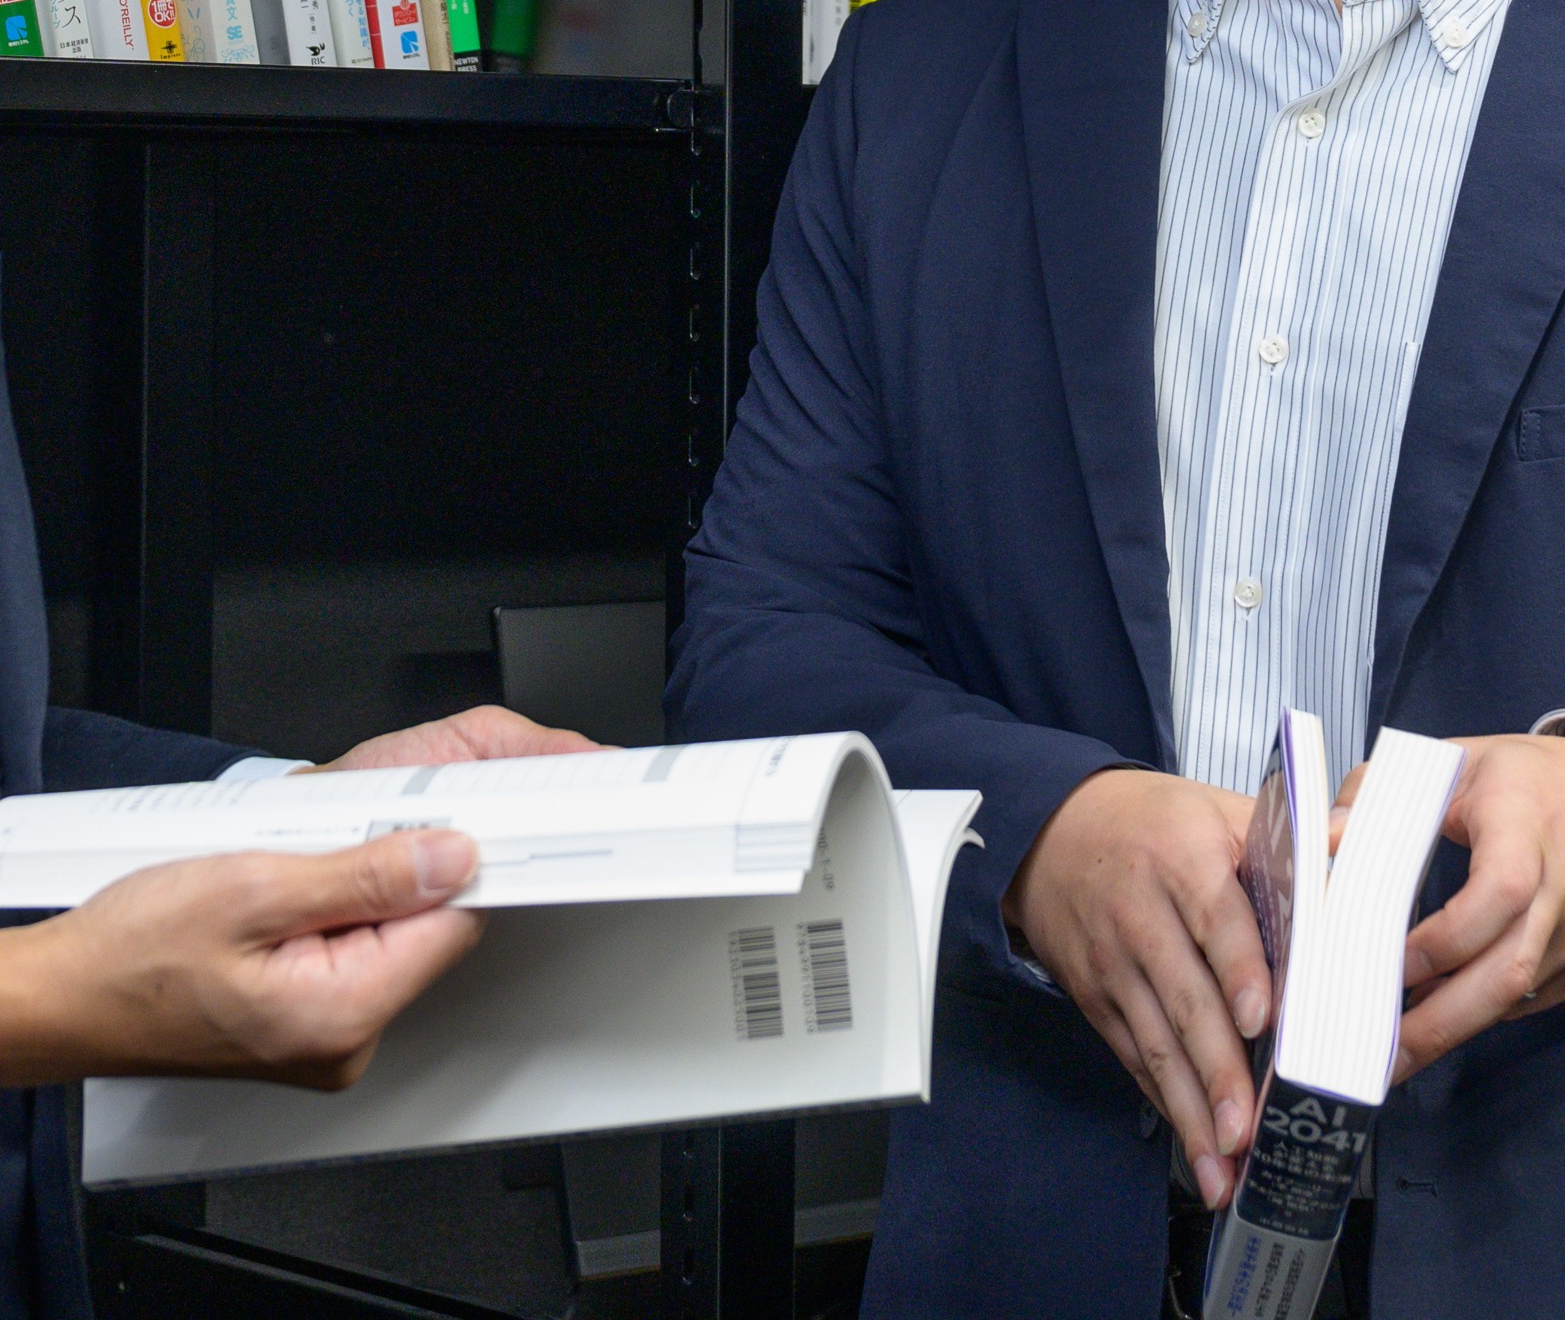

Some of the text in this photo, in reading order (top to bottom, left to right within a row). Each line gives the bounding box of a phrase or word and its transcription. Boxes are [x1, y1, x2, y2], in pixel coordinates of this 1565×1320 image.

[226, 25, 244, 41] SE
[311, 56, 326, 66] RIC
[454, 56, 479, 66] NEWTON
[1289, 1095, 1347, 1128] AI
[1262, 1105, 1368, 1154] 2041
